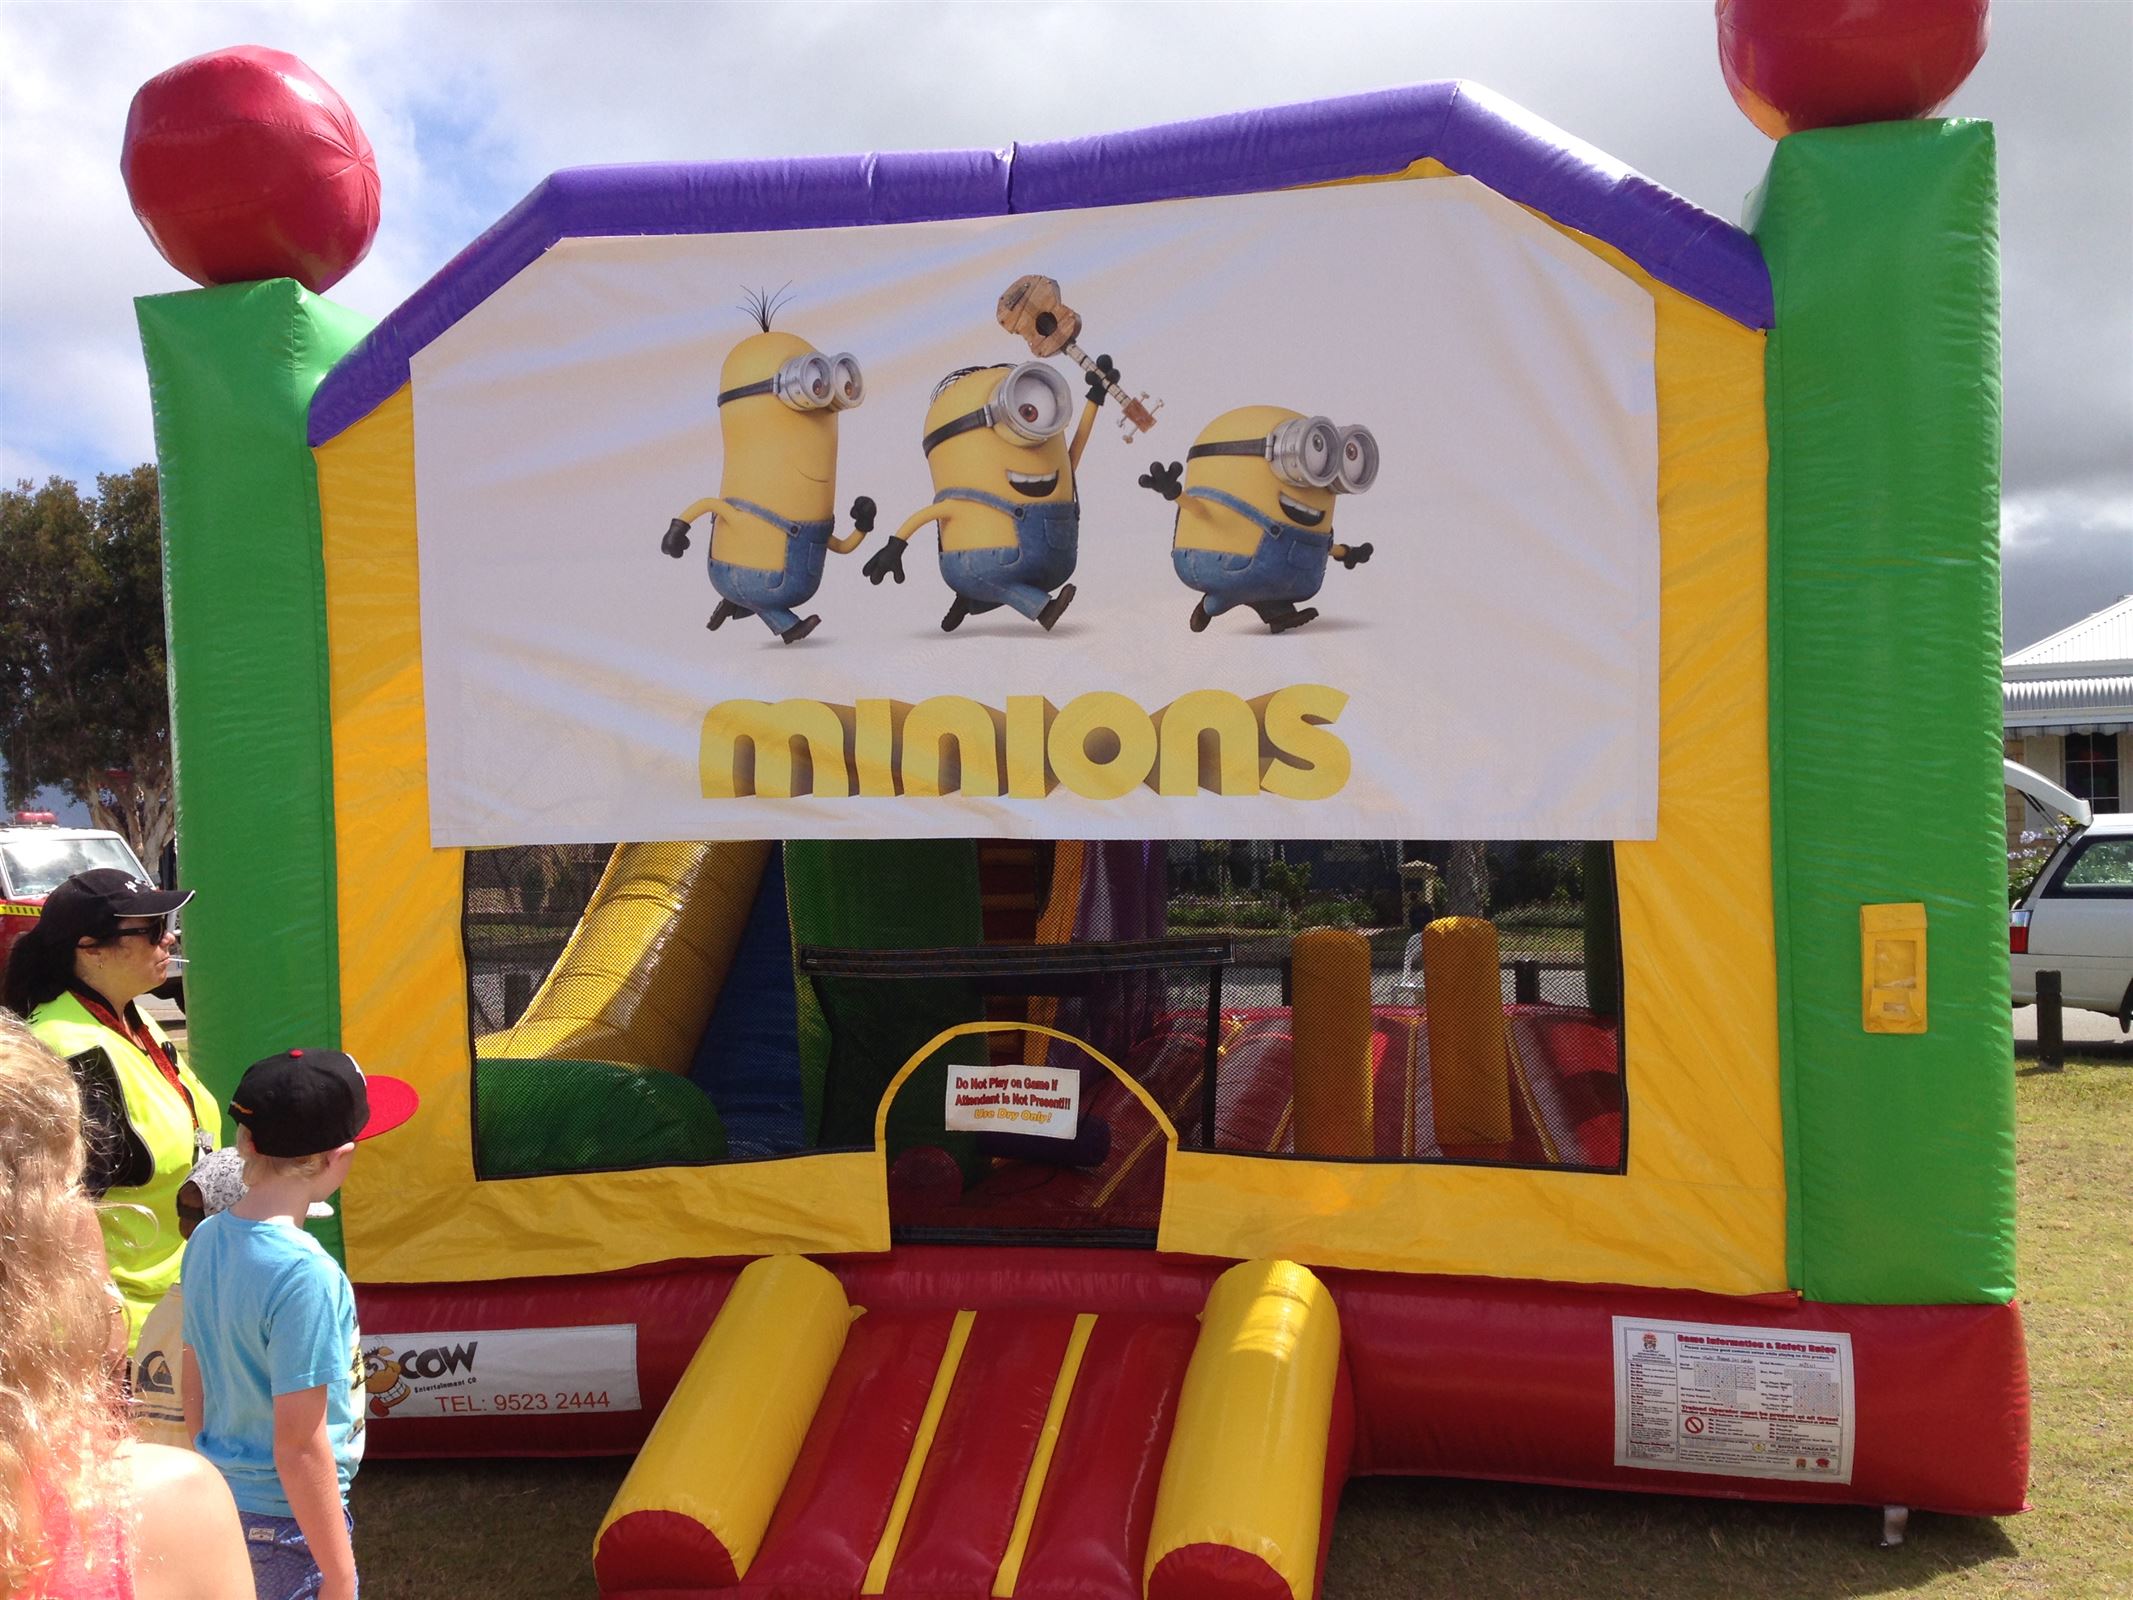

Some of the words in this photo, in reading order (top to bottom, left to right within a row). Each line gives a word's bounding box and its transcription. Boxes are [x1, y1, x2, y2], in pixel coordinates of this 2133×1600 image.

[956, 1077, 969, 1090] Do
[970, 1077, 987, 1090] Not
[989, 1077, 1009, 1091] Play
[1011, 1078, 1022, 1089] on
[1024, 1077, 1050, 1091] Game
[955, 1093, 1000, 1106] Attendant
[1012, 1092, 1029, 1106] Not
[974, 1108, 995, 1119] Use
[997, 1108, 1019, 1121] Dry
[1021, 1110, 1053, 1124] Only!
[1706, 1337, 1764, 1349] Information
[1775, 1342, 1807, 1352] Safety
[398, 1341, 478, 1380] COW
[415, 1379, 465, 1393] Entertainment
[435, 1396, 488, 1413] TEL:
[494, 1393, 548, 1411] 9523
[556, 1391, 611, 1409] 2444
